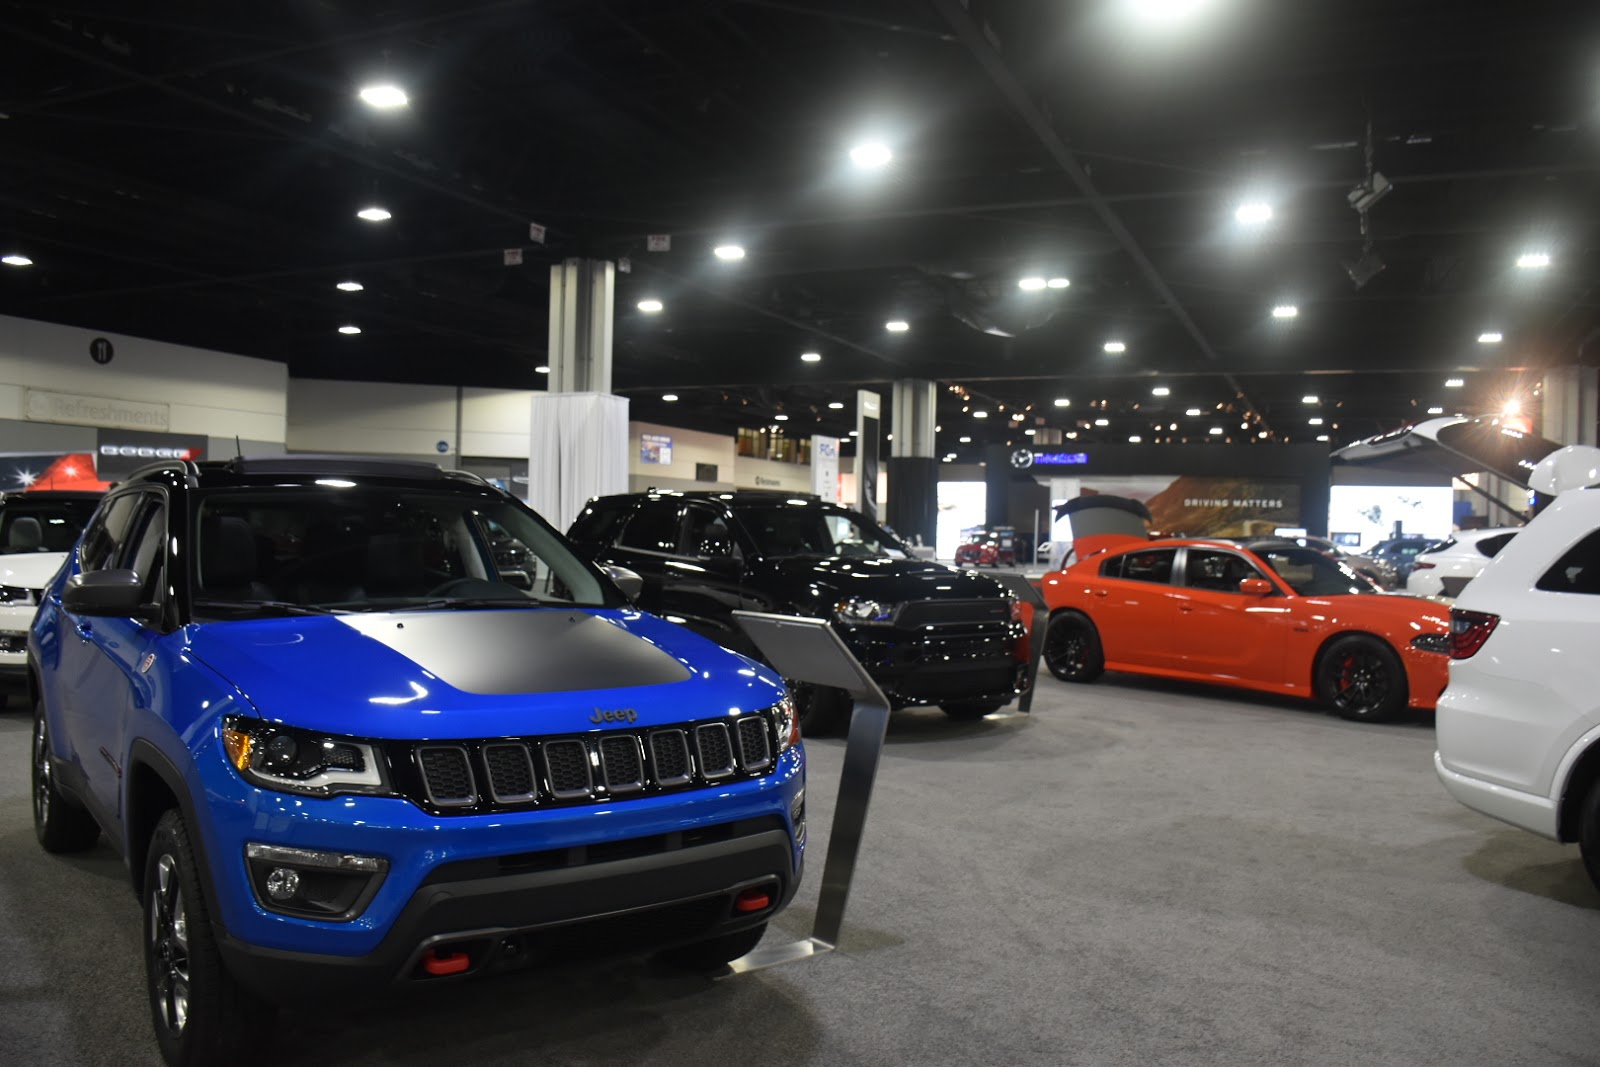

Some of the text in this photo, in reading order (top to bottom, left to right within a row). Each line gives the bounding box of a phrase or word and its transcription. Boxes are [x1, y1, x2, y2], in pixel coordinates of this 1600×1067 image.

[54, 399, 168, 426] Refreshments
[1183, 498, 1283, 509] DRIVING MATTERS
[589, 707, 638, 724] Jeep
